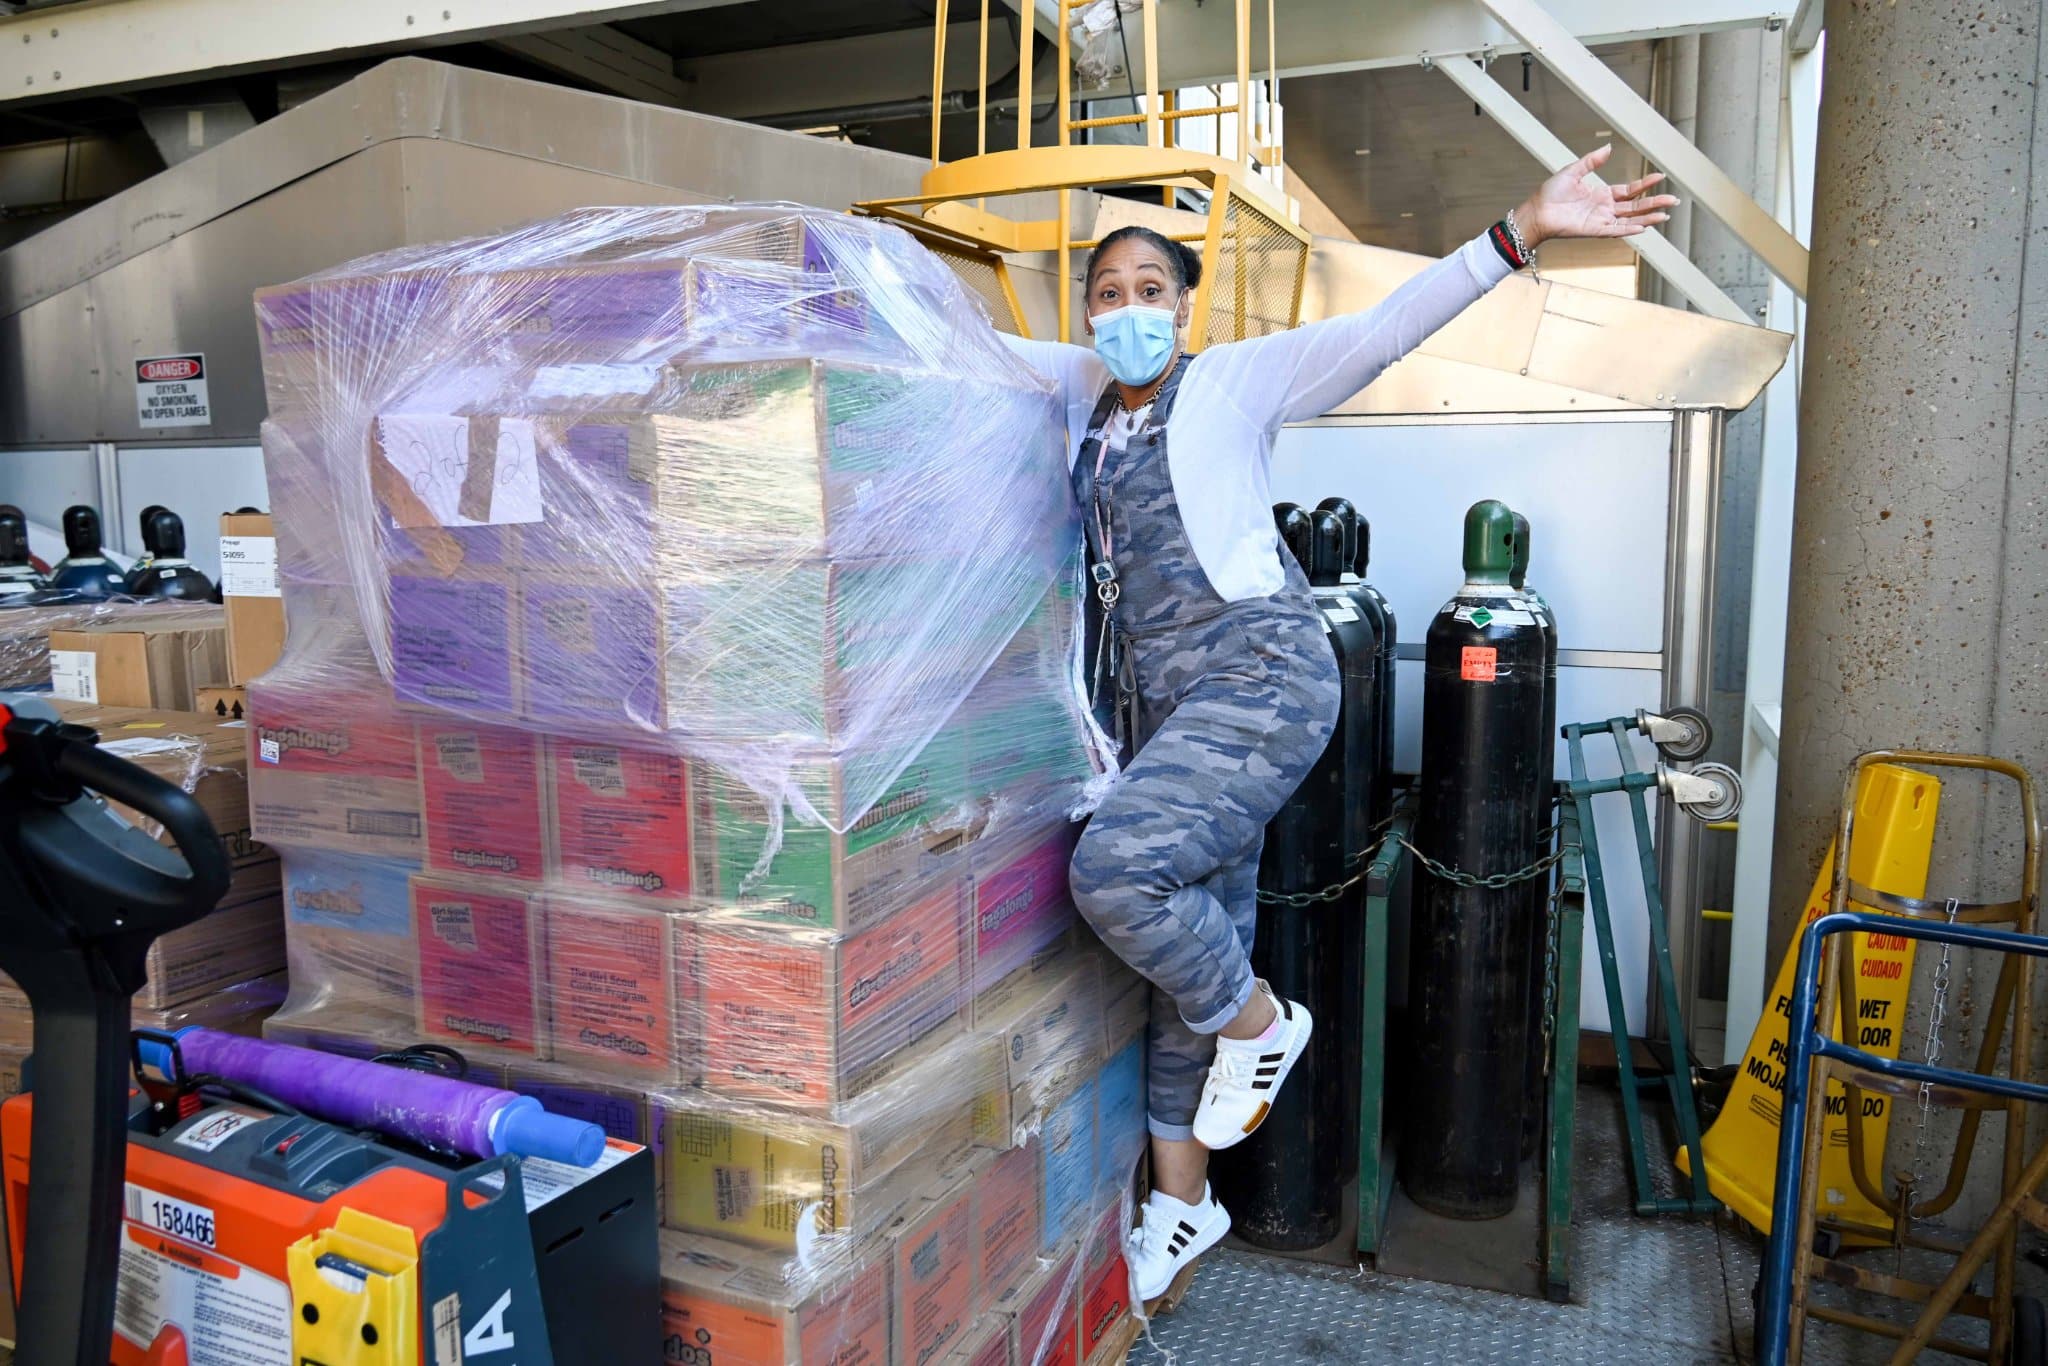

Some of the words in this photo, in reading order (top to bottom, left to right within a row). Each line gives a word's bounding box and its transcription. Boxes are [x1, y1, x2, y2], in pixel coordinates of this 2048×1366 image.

[147, 362, 192, 378] DANGER
[155, 383, 187, 395] OXYGEN
[147, 396, 159, 407] NO
[160, 394, 198, 407] SMOKING
[141, 409, 153, 419] NO
[154, 407, 175, 419] OPEN
[176, 405, 208, 417] FLAMES
[452, 848, 519, 873] tagalongs
[570, 966, 588, 977] The
[609, 974, 637, 989] Scout
[1860, 958, 1904, 980] CUIDADO
[570, 980, 604, 994] Cookie
[1859, 998, 1891, 1020] WET
[444, 1014, 513, 1043] tagalongs
[1860, 1027, 1892, 1047] OOR
[1767, 1037, 1790, 1066] PIS
[1746, 1056, 1785, 1097] MOJA
[1824, 1096, 1885, 1118] MODO
[152, 1200, 216, 1246] 158466
